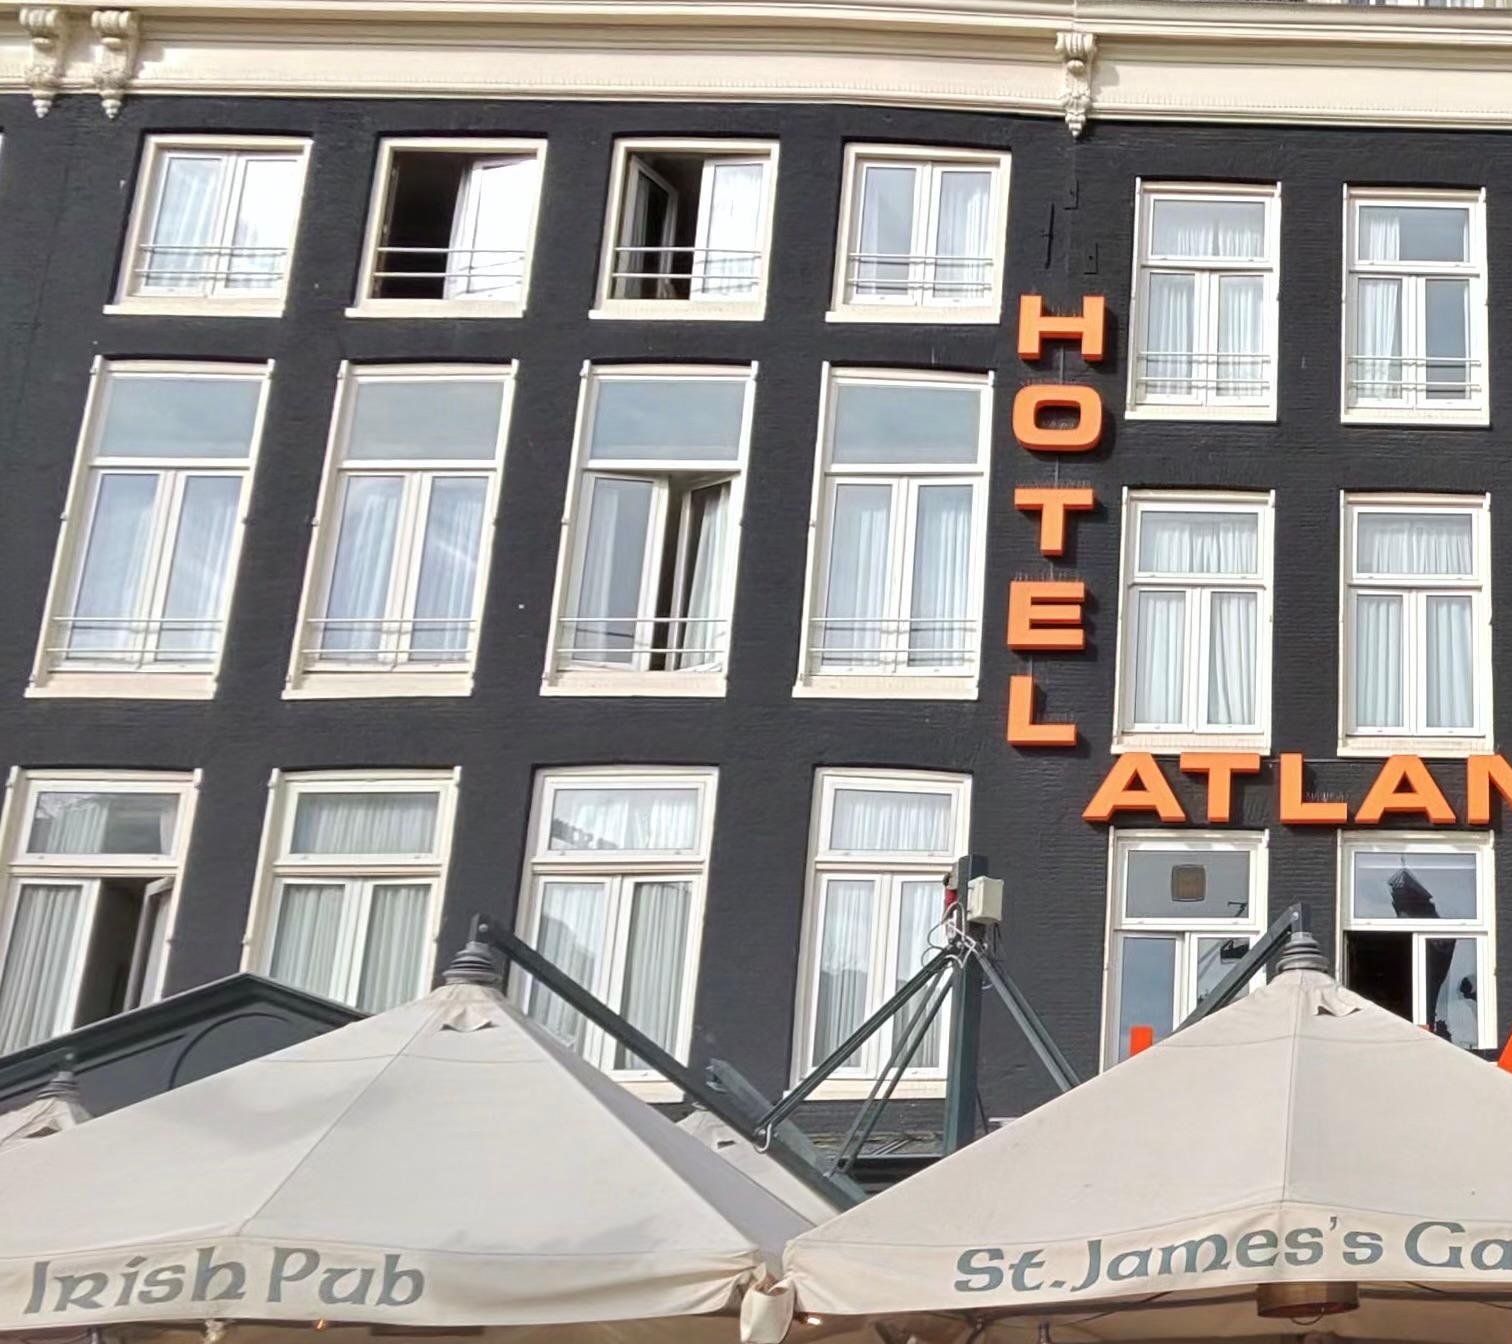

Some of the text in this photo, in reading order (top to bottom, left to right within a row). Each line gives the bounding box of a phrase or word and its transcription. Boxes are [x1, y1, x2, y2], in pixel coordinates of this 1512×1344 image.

[1007, 295, 1105, 747] HOTEL
[23, 1246, 426, 1314] Irish Pub
